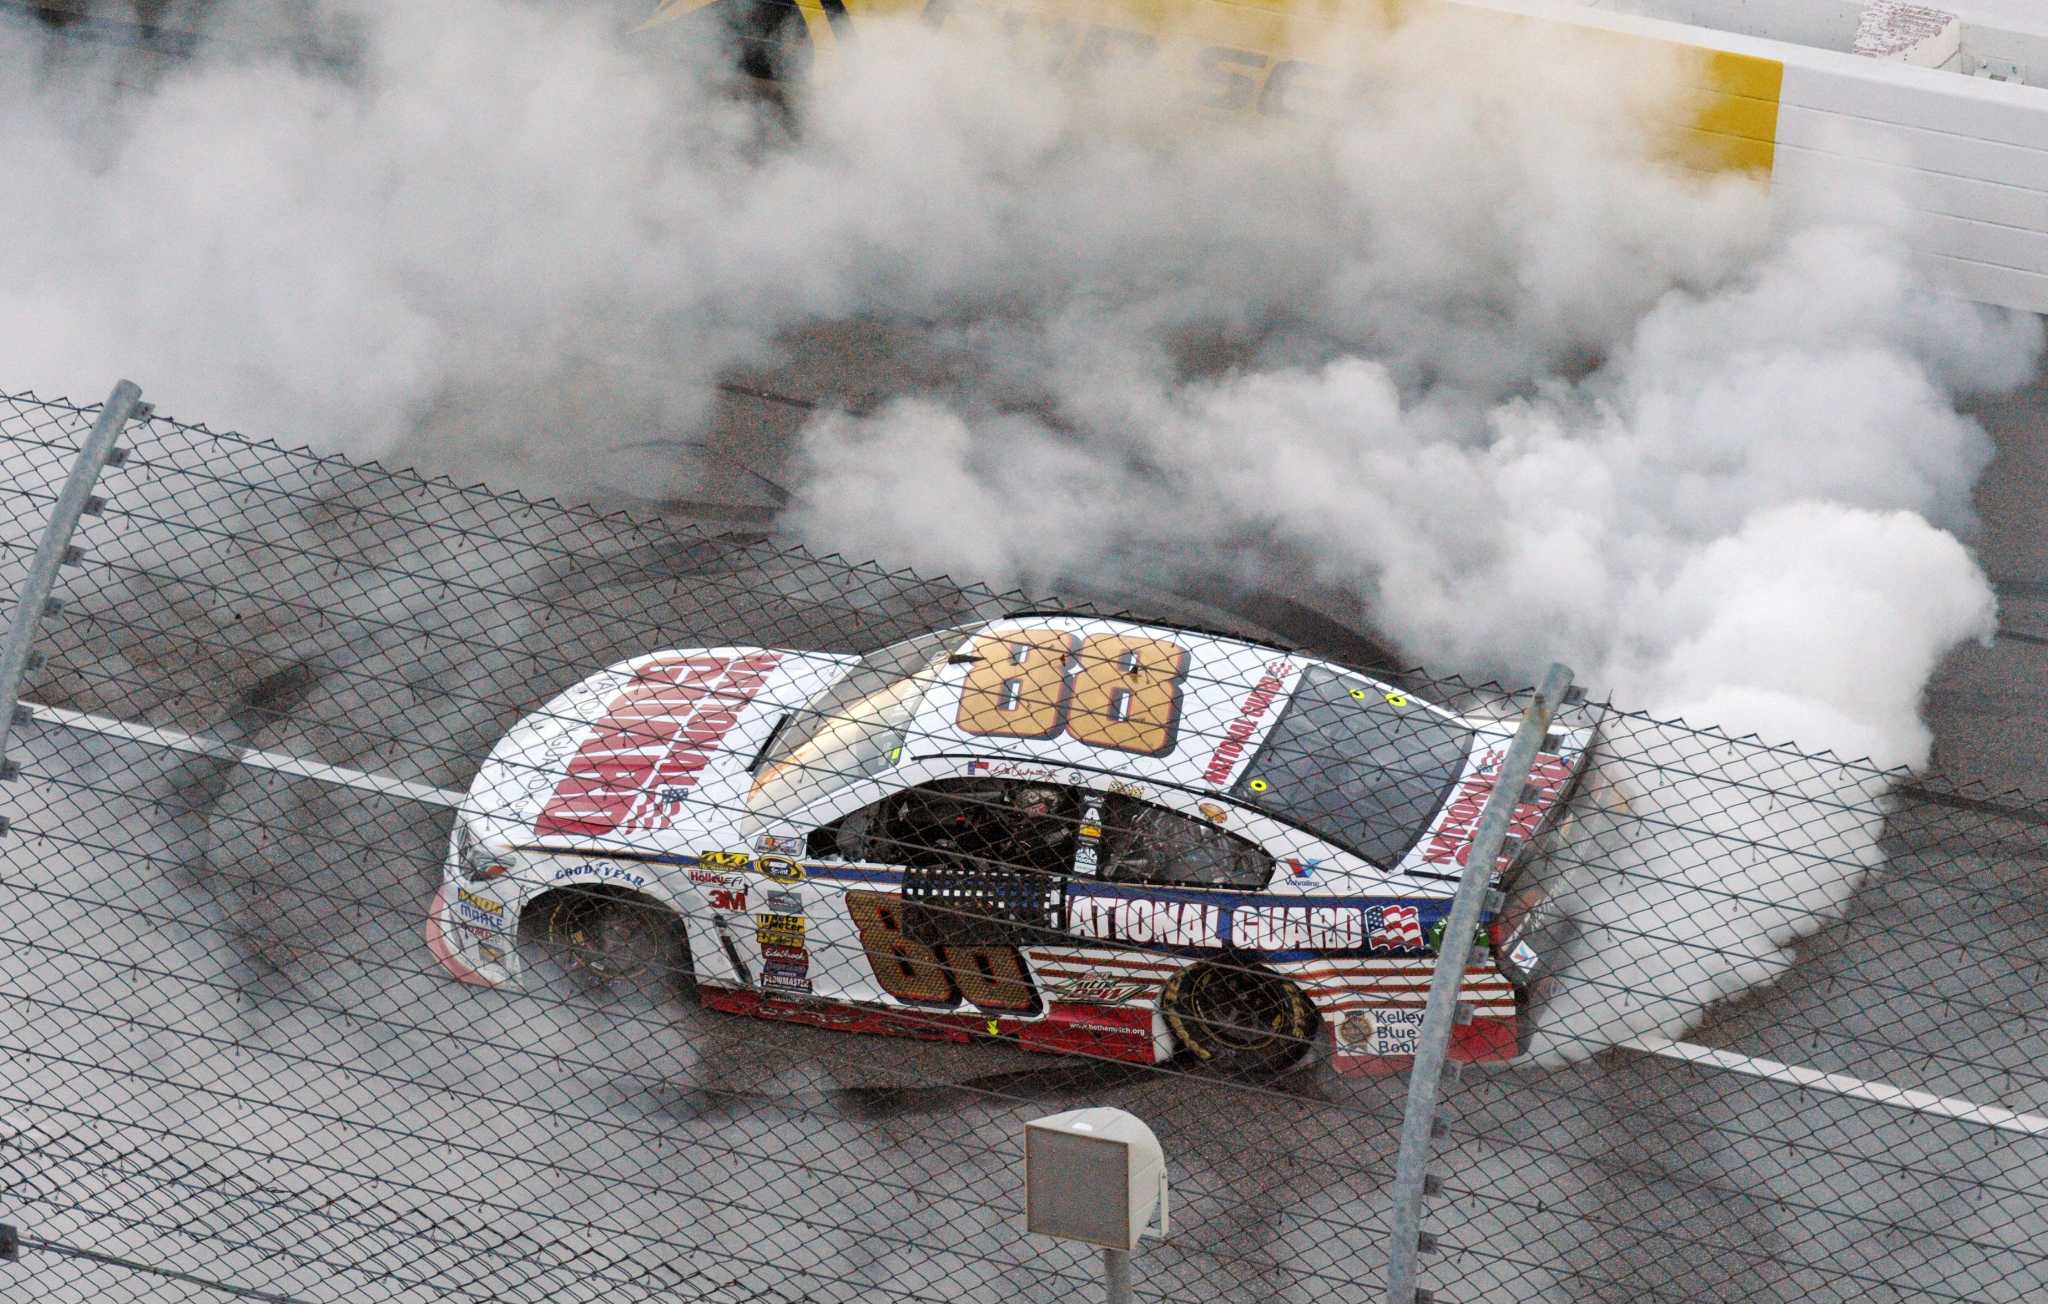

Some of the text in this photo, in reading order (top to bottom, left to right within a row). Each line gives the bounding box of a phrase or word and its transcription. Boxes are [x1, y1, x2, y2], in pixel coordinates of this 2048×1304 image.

[955, 629, 1191, 758] 88
[1203, 676, 1283, 785] NATIONAL GUARD
[533, 654, 783, 836] NATIONAL GUARD
[554, 861, 646, 887] GOODYEAR
[690, 870, 726, 886] Holley
[708, 889, 747, 913] 3M
[1232, 904, 1363, 951] GUARD
[1375, 1010, 1424, 1026] Kelley
[1377, 1026, 1416, 1039] Blue
